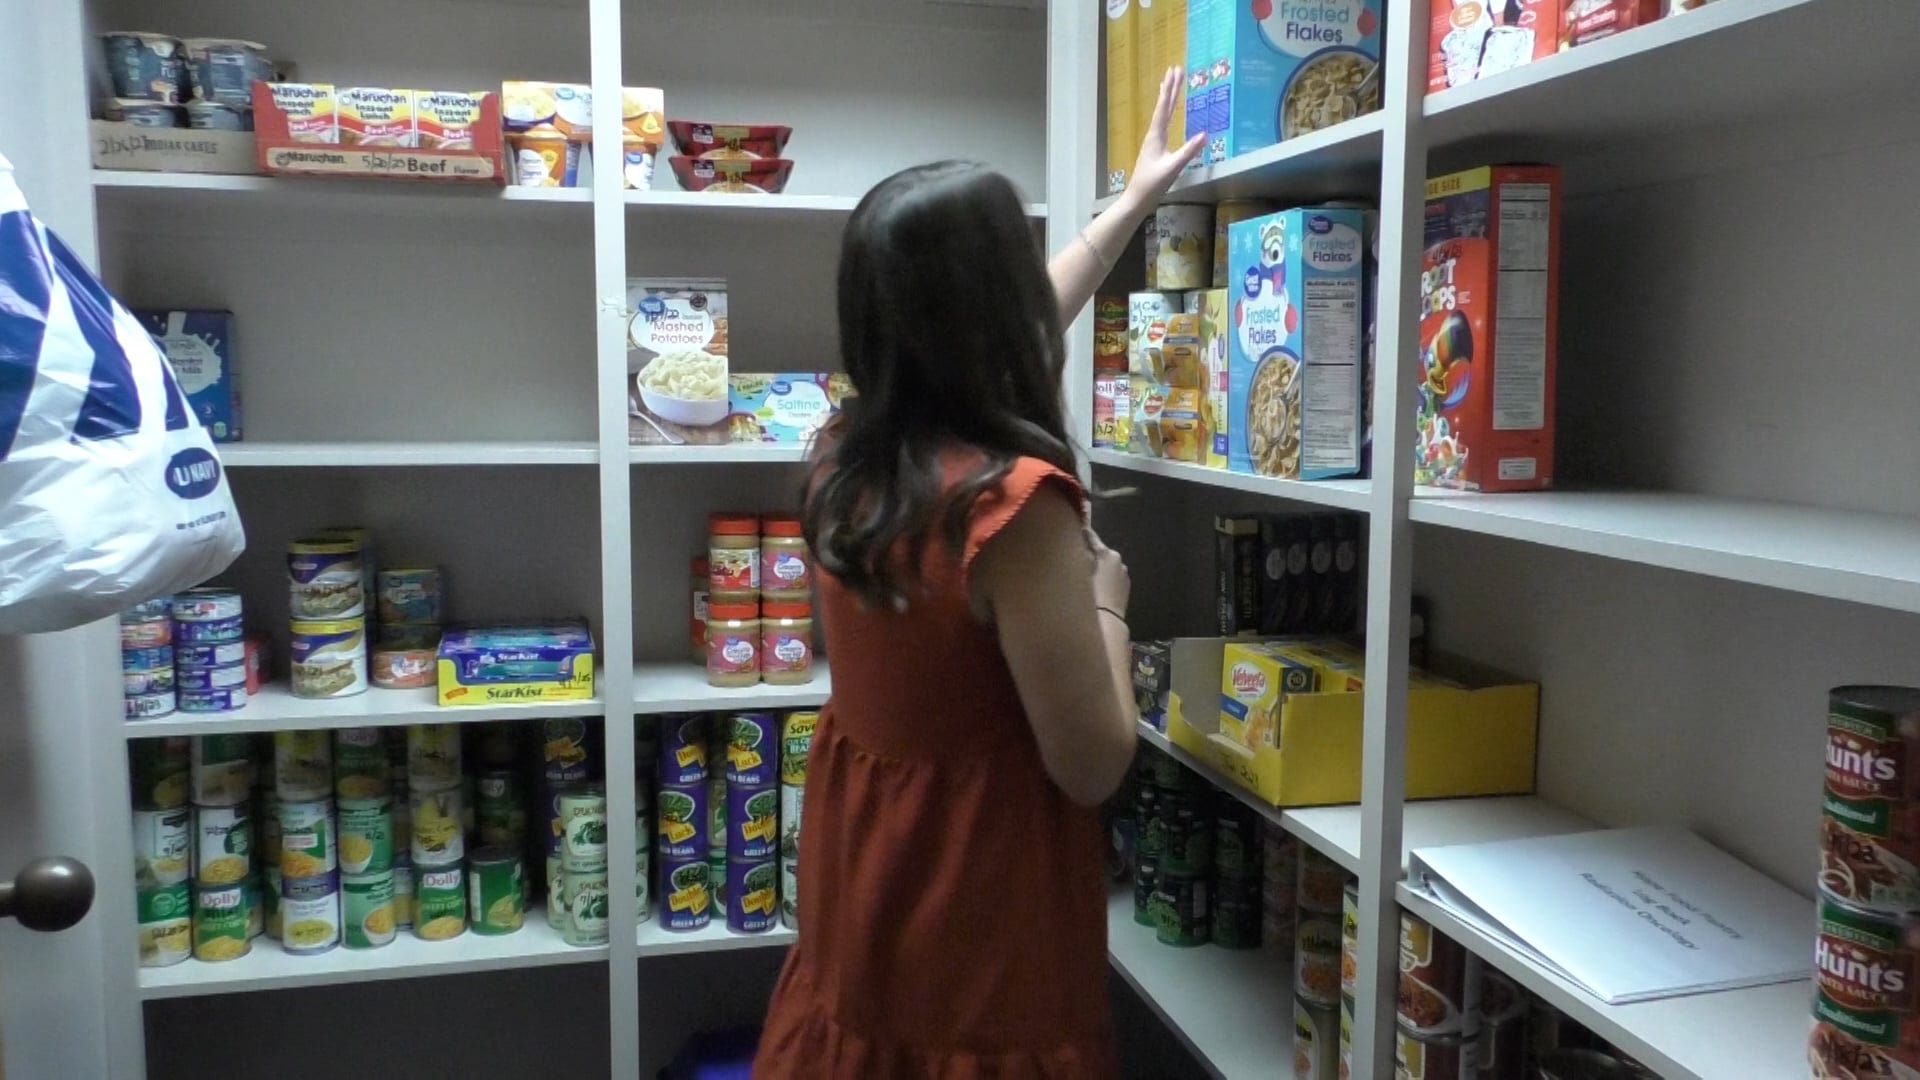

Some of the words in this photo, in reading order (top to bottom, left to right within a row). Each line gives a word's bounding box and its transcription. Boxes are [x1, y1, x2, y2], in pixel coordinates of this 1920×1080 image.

[1281, 1, 1350, 24] Frosted
[1286, 22, 1344, 44] Flakes
[351, 92, 407, 104] Maruchan
[407, 160, 446, 174] Beef
[1442, 176, 1462, 192] SIZE
[1308, 238, 1356, 250] Frosted
[1312, 250, 1353, 262] Flakes
[1246, 304, 1280, 326] Frosted
[654, 321, 704, 332] Mashed
[650, 333, 704, 344] Potatoes
[1248, 325, 1277, 346] Flakes
[776, 399, 821, 410] Saltine
[190, 458, 216, 483] NAVY
[1232, 666, 1266, 688] Velveeta
[486, 686, 542, 700] StarKist
[735, 753, 760, 768] Luck
[738, 775, 760, 784] BEANS
[669, 826, 695, 840] Luck
[673, 846, 696, 856] BEANS
[744, 846, 766, 857] GREEN
[424, 872, 460, 889] Dolly
[1580, 872, 1638, 911] Radiation
[1637, 910, 1700, 950] Oncology
[671, 918, 694, 929] GREEN
[1817, 1000, 1886, 1034] Traditional
